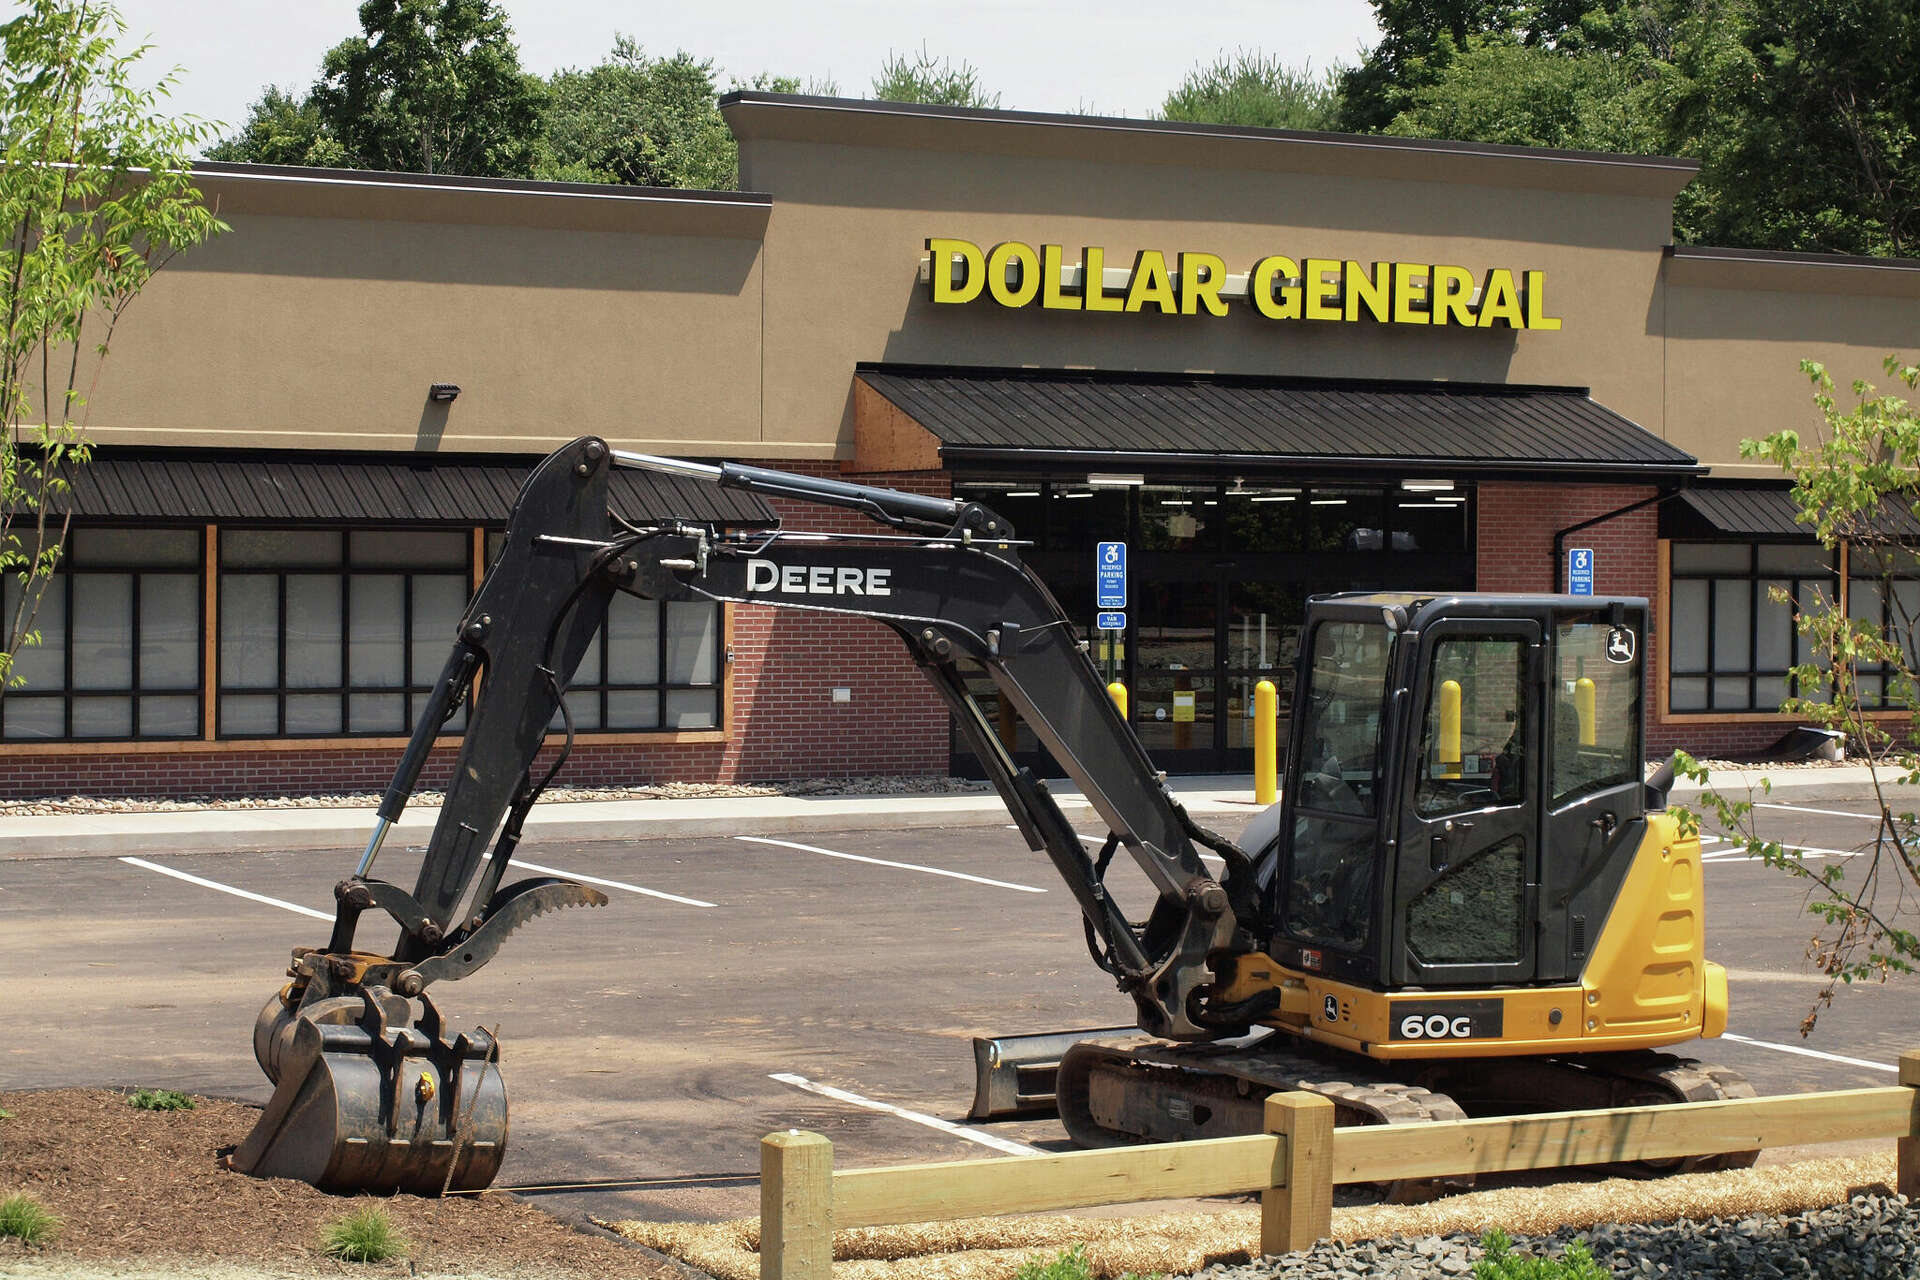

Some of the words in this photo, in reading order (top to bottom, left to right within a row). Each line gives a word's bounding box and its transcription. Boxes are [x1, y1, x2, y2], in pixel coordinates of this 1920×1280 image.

[927, 238, 1229, 317] DOLLAR
[1250, 255, 1562, 330] GENERAL
[747, 558, 892, 596] DEERE
[1100, 571, 1123, 579] PARKING
[1400, 1014, 1472, 1039] 60G
